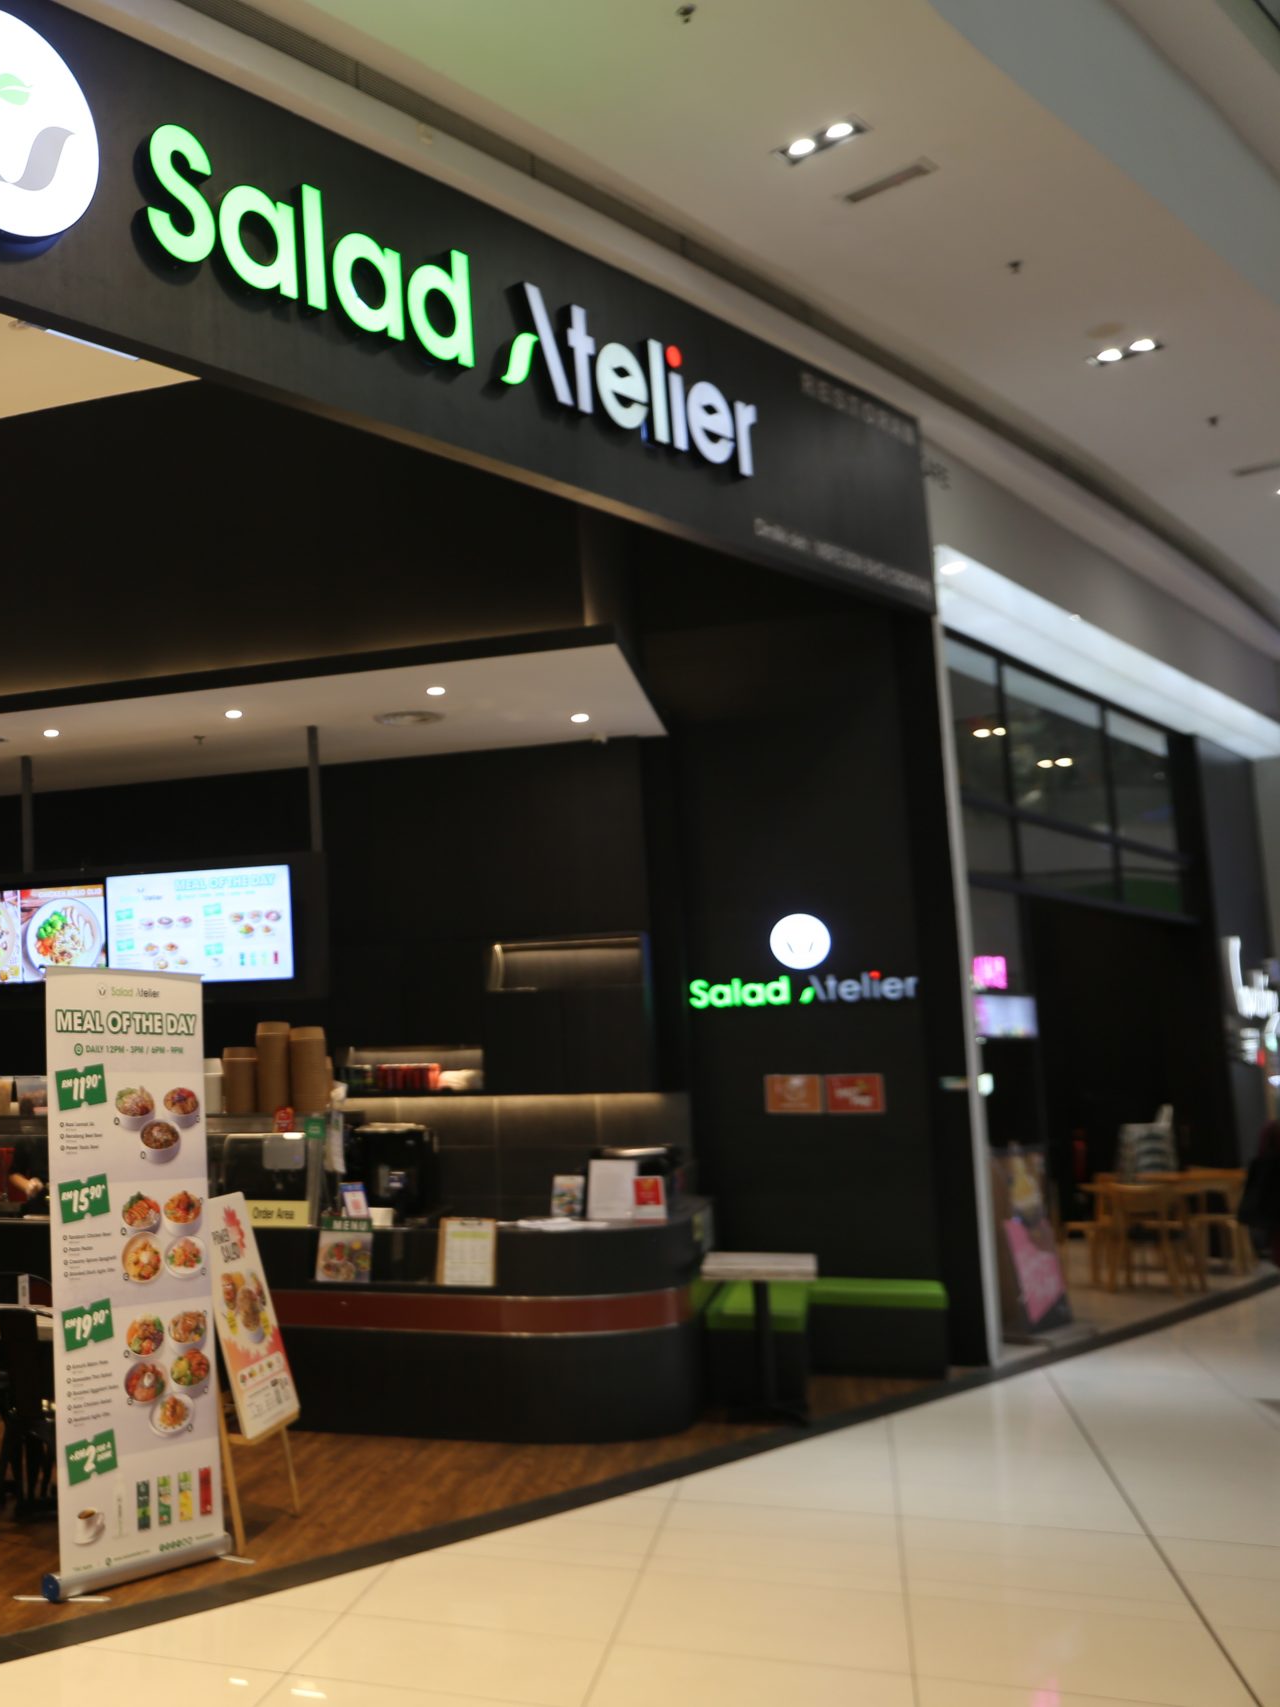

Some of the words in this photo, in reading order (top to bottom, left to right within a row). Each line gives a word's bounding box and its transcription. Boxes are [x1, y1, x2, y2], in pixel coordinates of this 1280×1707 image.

[147, 124, 475, 368] Salad
[501, 281, 757, 477] Atelier
[111, 986, 134, 997] Salad
[689, 974, 791, 1009] Salad
[799, 970, 918, 1003] Atelier
[55, 1009, 104, 1034] MEAL
[107, 1010, 131, 1035] OF
[131, 1011, 163, 1035] THE
[166, 1013, 196, 1036] DAY
[85, 1044, 105, 1054] DAILY
[252, 1206, 275, 1219] Order
[276, 1207, 295, 1220] Area
[332, 1218, 368, 1231] MENU
